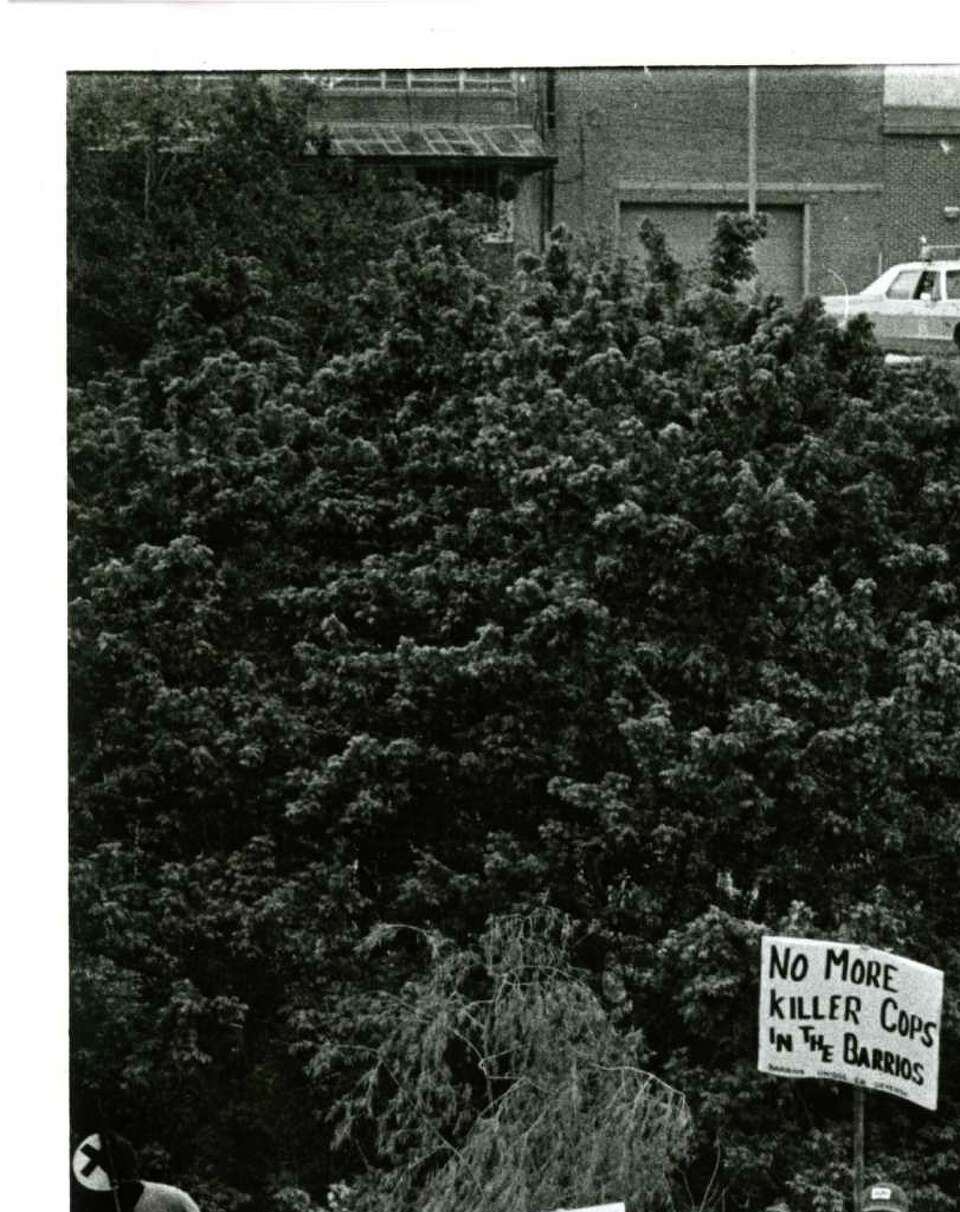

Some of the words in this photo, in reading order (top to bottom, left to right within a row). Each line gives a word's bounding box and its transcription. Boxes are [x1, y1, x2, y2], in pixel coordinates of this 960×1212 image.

[768, 944, 809, 982] NO
[825, 948, 898, 993] MORE
[769, 988, 861, 1025] KILLER
[880, 997, 937, 1048] COPS
[769, 1026, 793, 1053] IN
[797, 1025, 835, 1063] THE
[843, 1032, 925, 1087] BARRIOS
